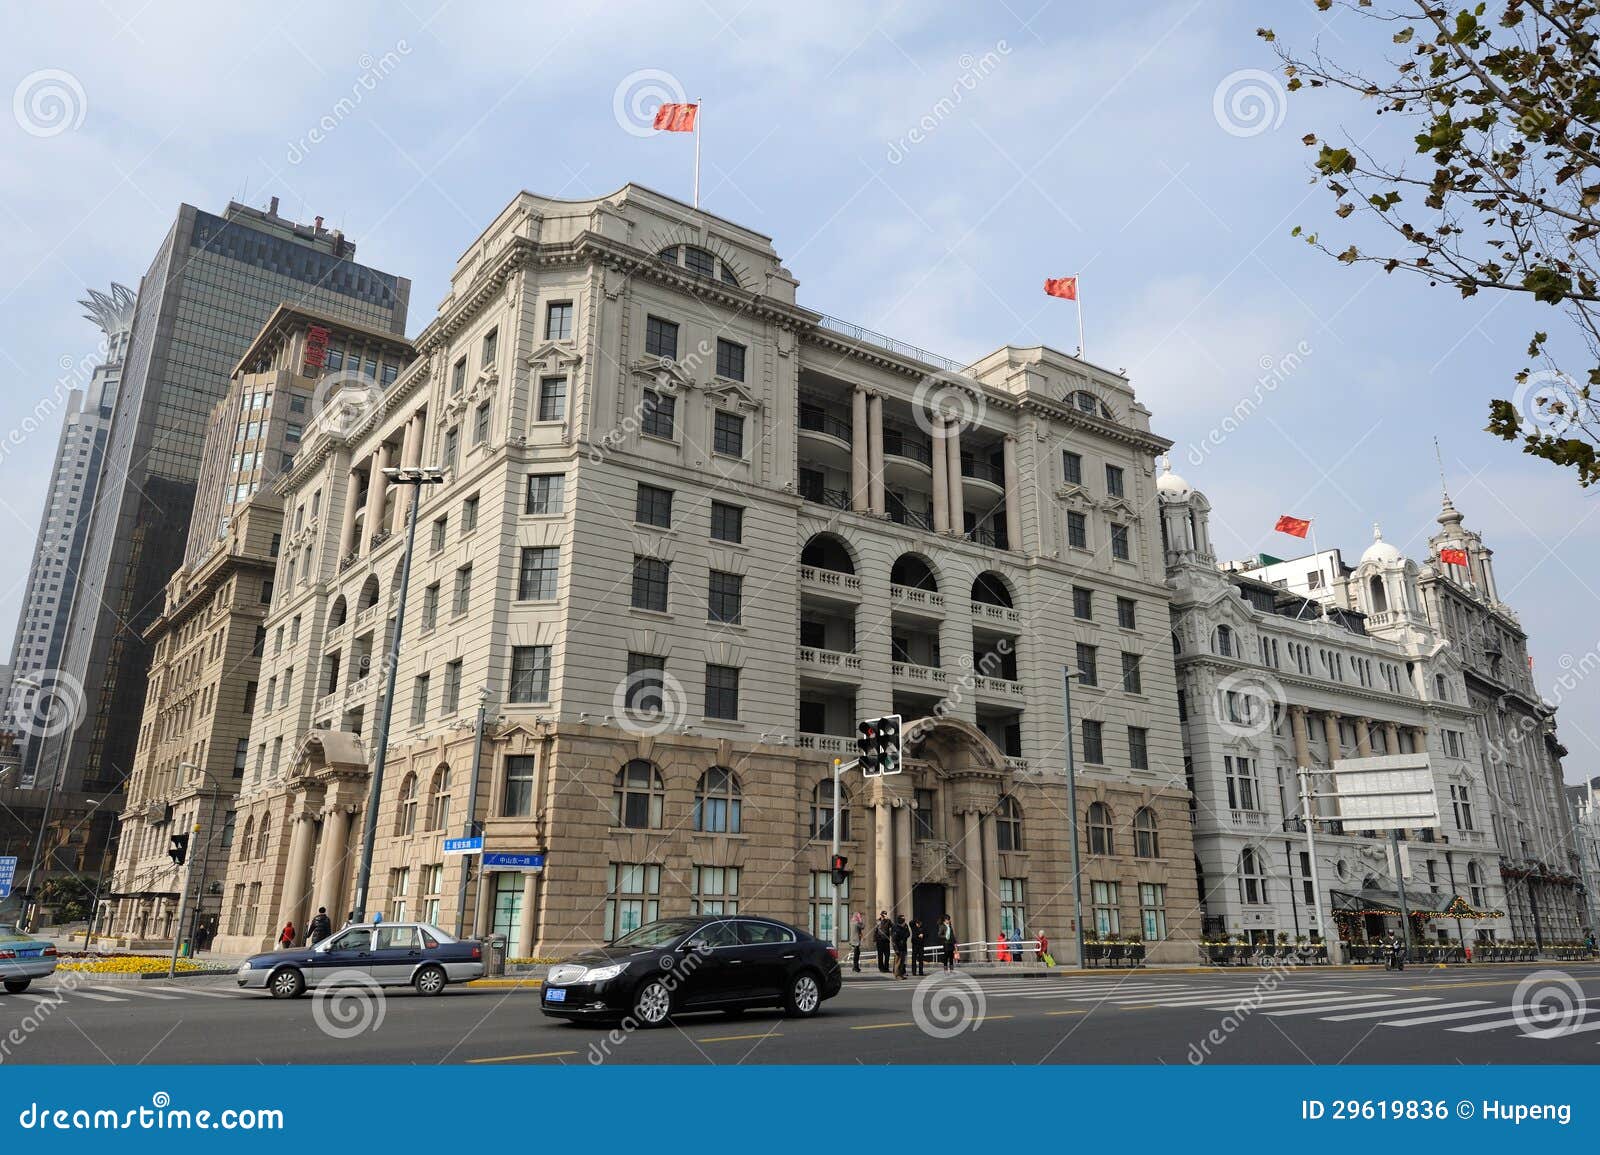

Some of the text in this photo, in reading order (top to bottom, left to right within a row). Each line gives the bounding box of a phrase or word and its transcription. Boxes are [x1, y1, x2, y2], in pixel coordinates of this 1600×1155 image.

[499, 857, 531, 865] 中山东一路
